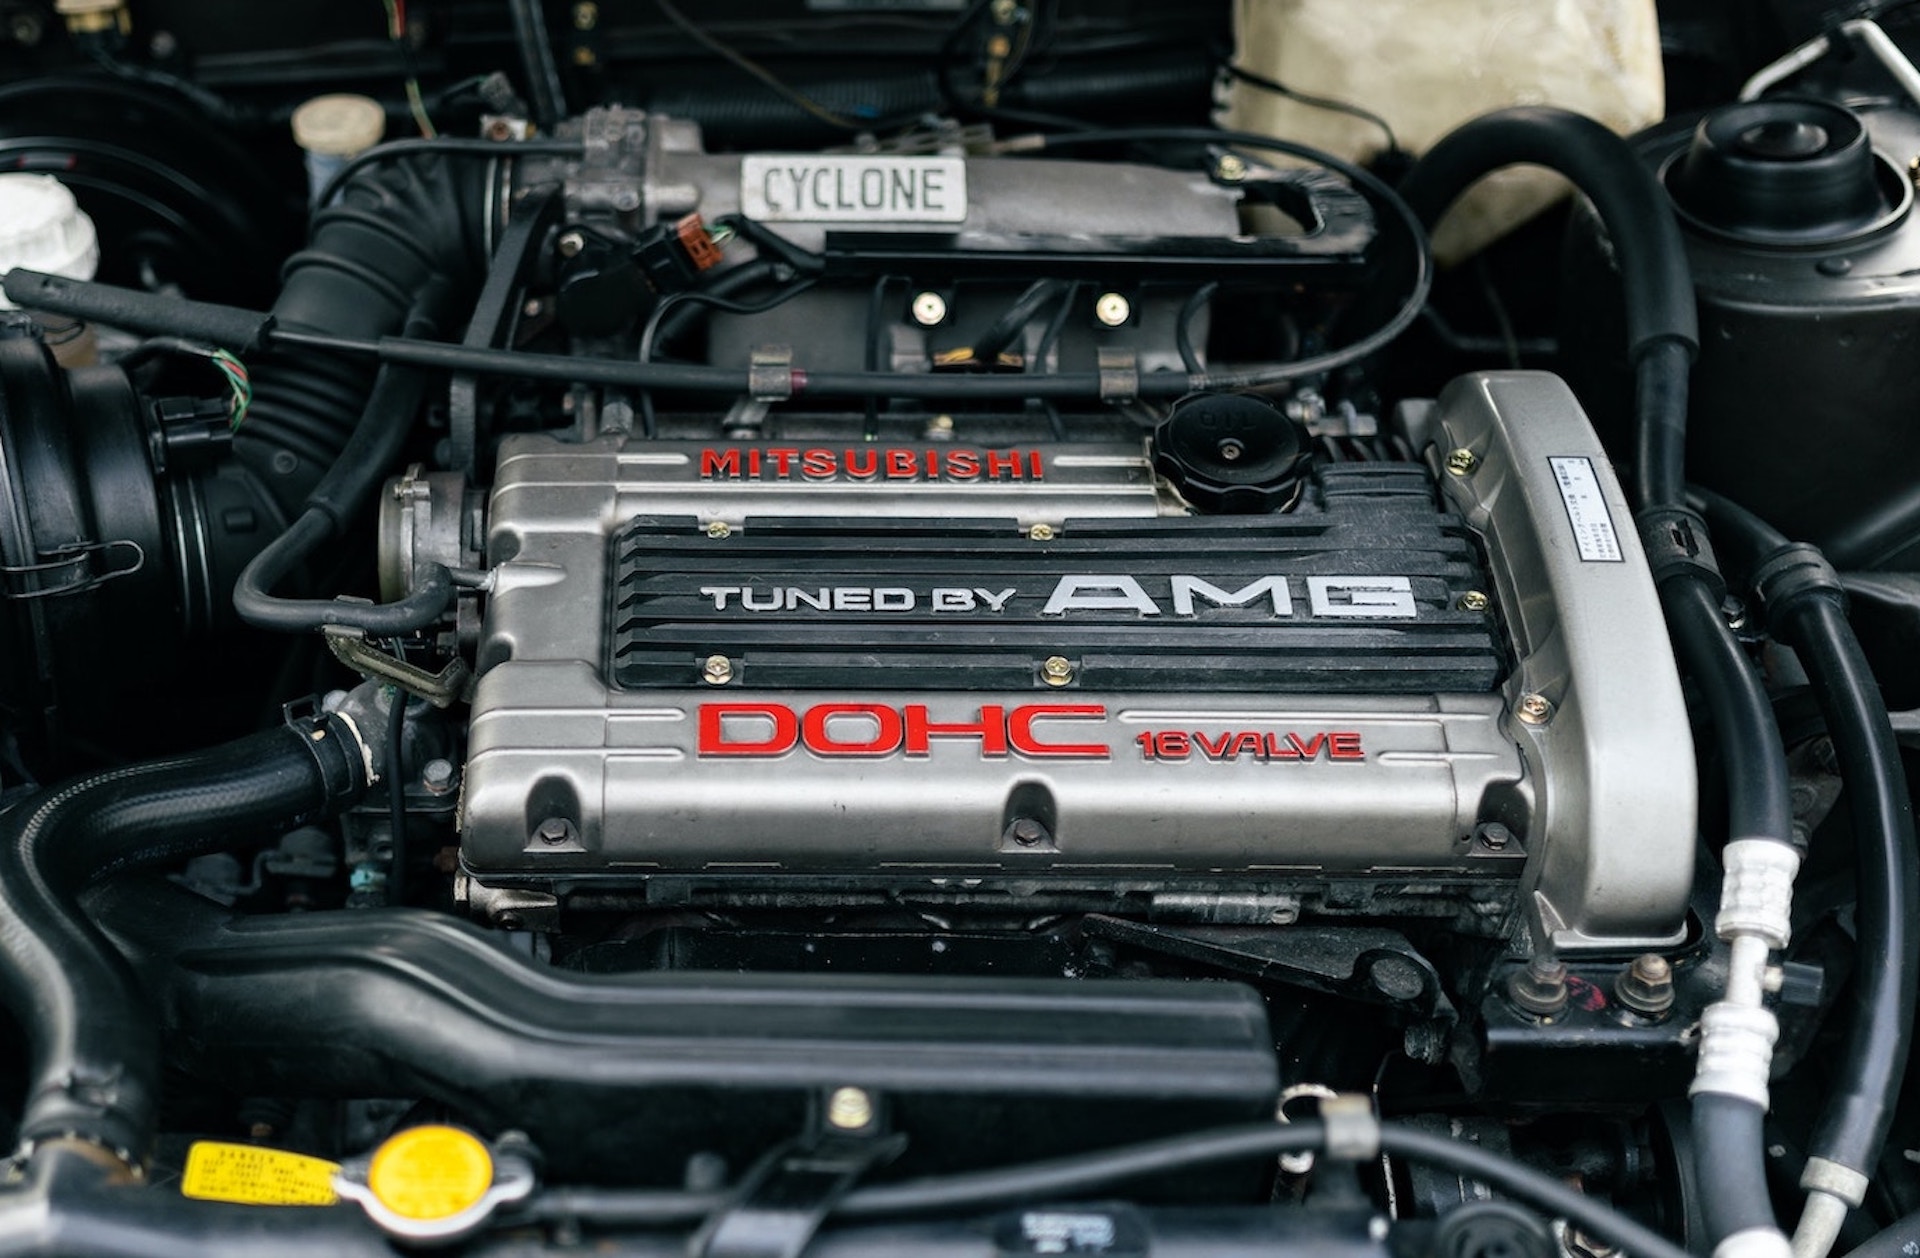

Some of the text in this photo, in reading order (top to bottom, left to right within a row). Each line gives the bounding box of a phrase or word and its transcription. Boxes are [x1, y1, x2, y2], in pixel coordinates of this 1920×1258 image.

[764, 168, 945, 211] CYCLONE
[700, 449, 1044, 479] MITSUBISHI
[700, 574, 1418, 619] TUNED BY AMG
[697, 703, 1111, 759] DOHC
